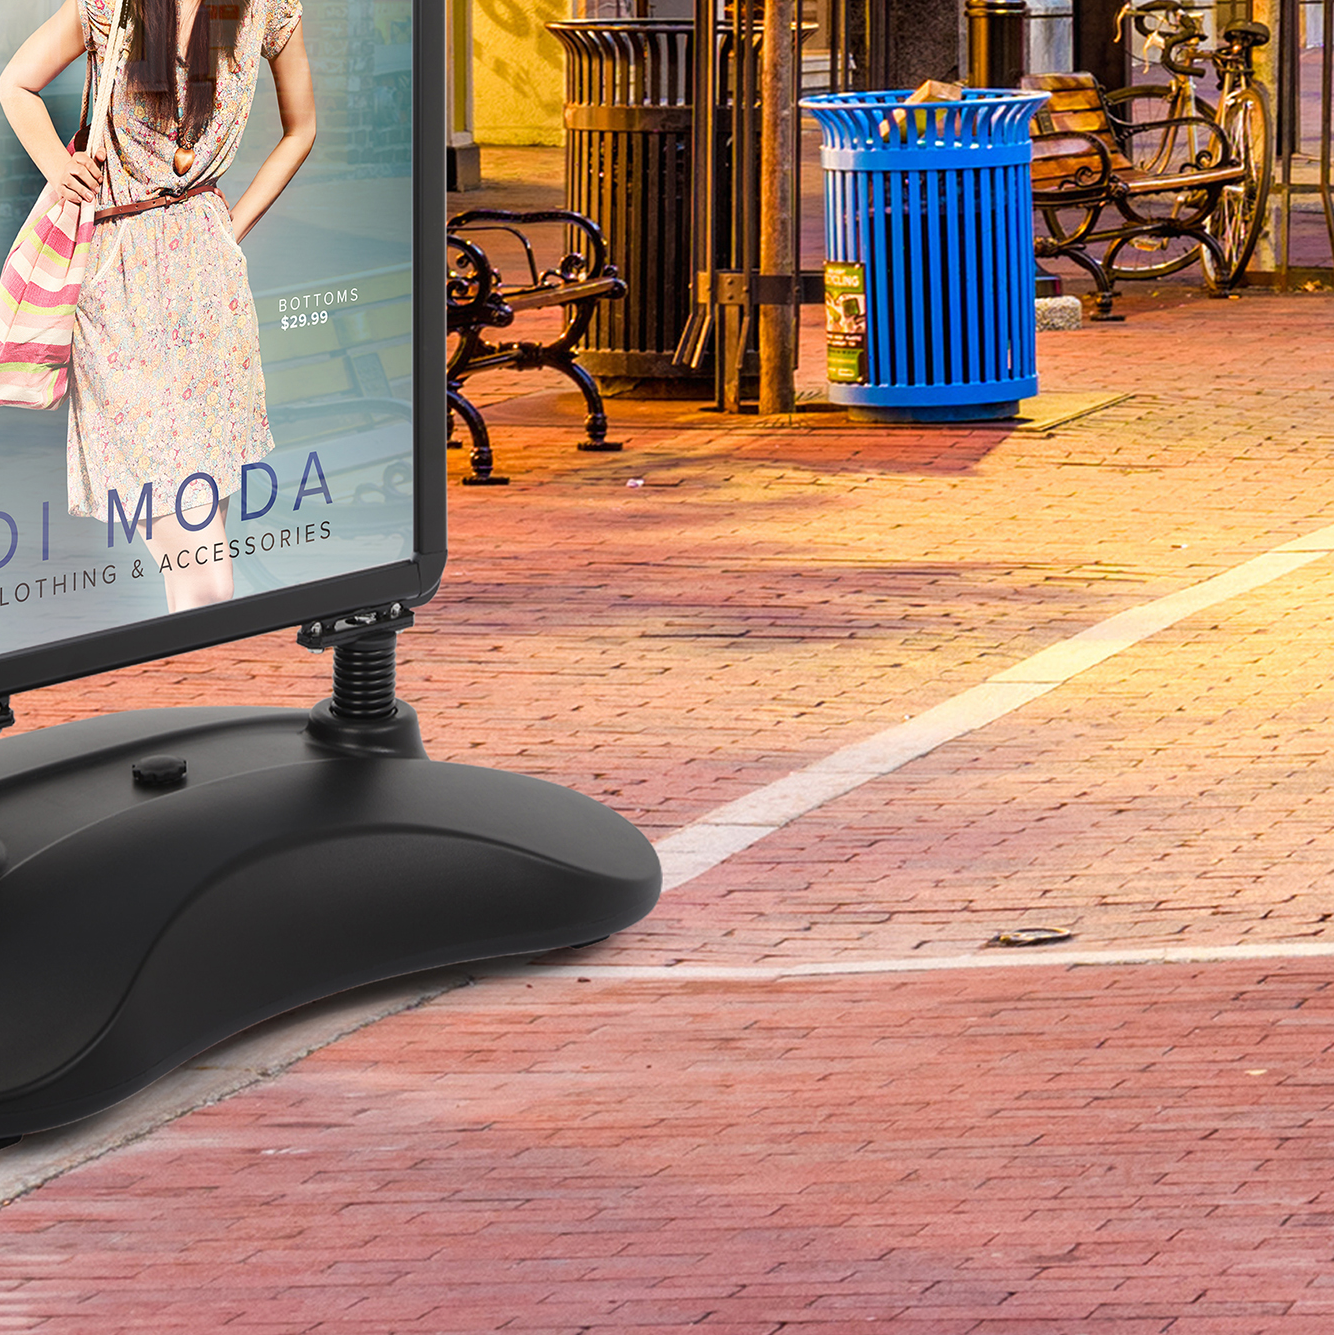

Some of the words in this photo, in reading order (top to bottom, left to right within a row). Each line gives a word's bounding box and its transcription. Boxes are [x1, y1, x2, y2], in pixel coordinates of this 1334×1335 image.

[279, 287, 359, 312] BOTTOMS
[281, 310, 329, 332] $29.99
[107, 450, 333, 549] MODA
[131, 558, 145, 580] &
[158, 520, 332, 574] ACCESSORIES
